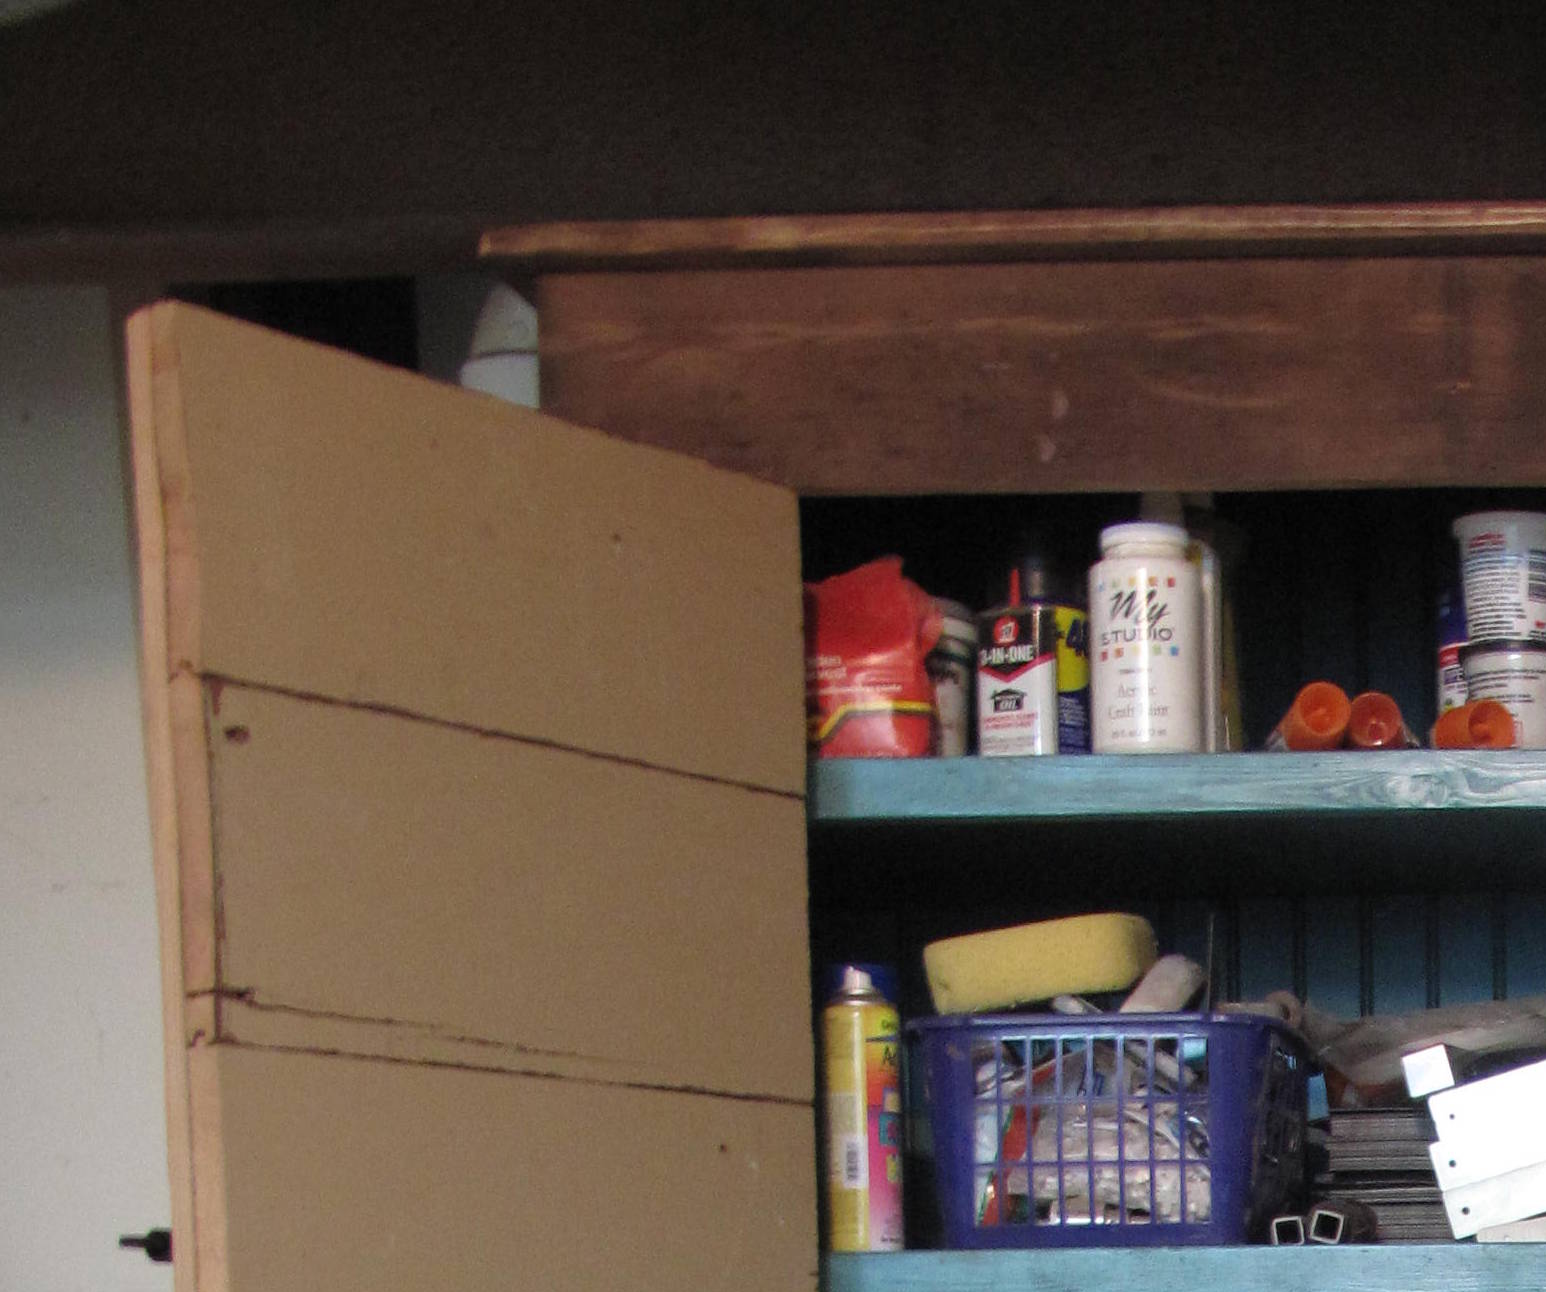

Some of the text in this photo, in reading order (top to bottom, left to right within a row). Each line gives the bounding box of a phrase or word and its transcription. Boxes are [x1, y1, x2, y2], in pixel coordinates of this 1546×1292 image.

[1109, 589, 1171, 627] My
[1101, 627, 1173, 647] STUIO
[980, 644, 1034, 666] 3-IN-ONE
